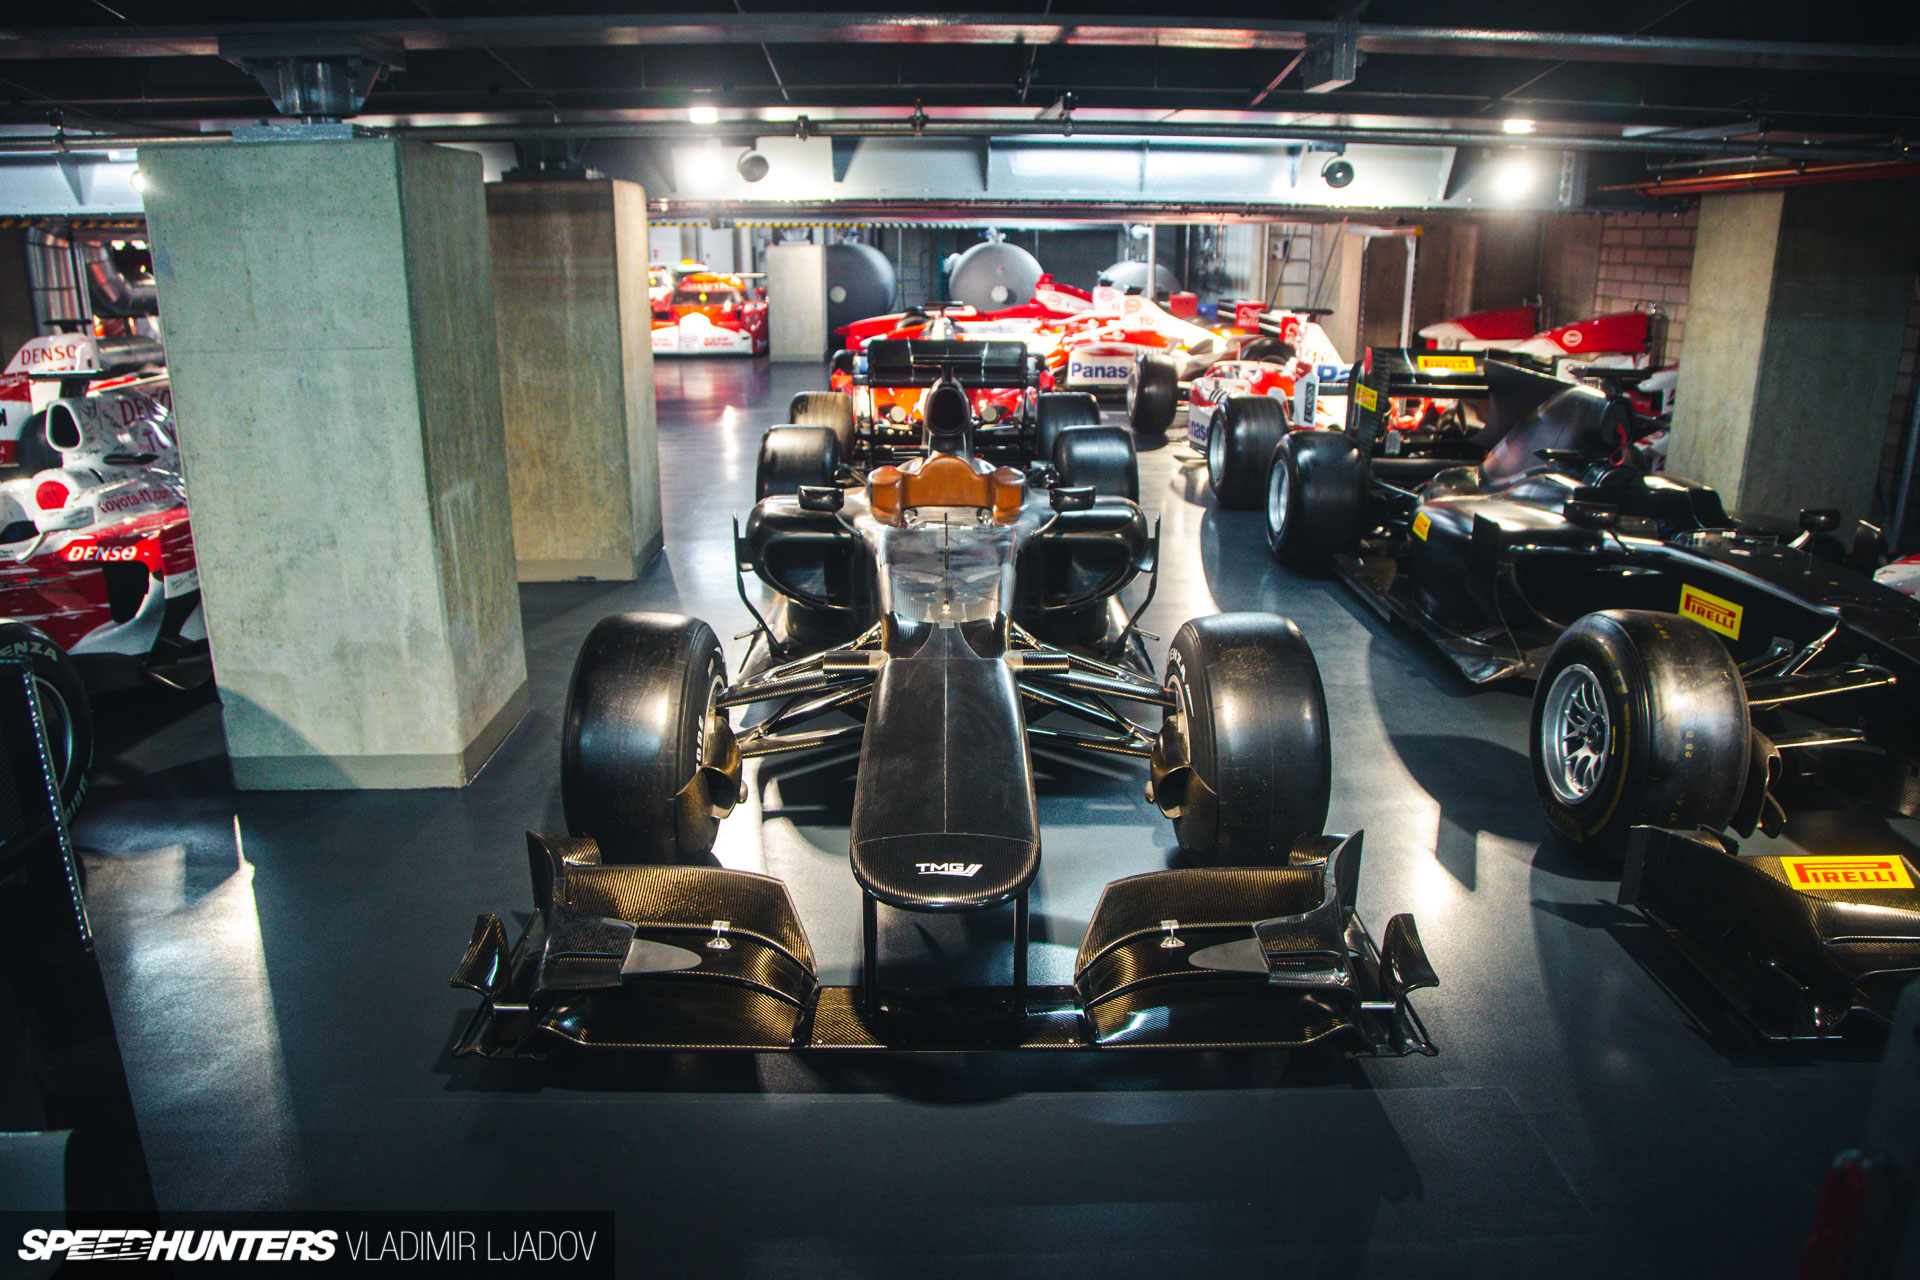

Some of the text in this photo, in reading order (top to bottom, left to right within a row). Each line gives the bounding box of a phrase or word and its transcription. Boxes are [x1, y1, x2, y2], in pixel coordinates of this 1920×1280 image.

[21, 344, 77, 366] DENSO
[68, 546, 138, 562] DENSO
[1684, 593, 1737, 630] PIRELLI
[916, 863, 970, 874] TMG
[1793, 862, 1898, 884] PIRELLI
